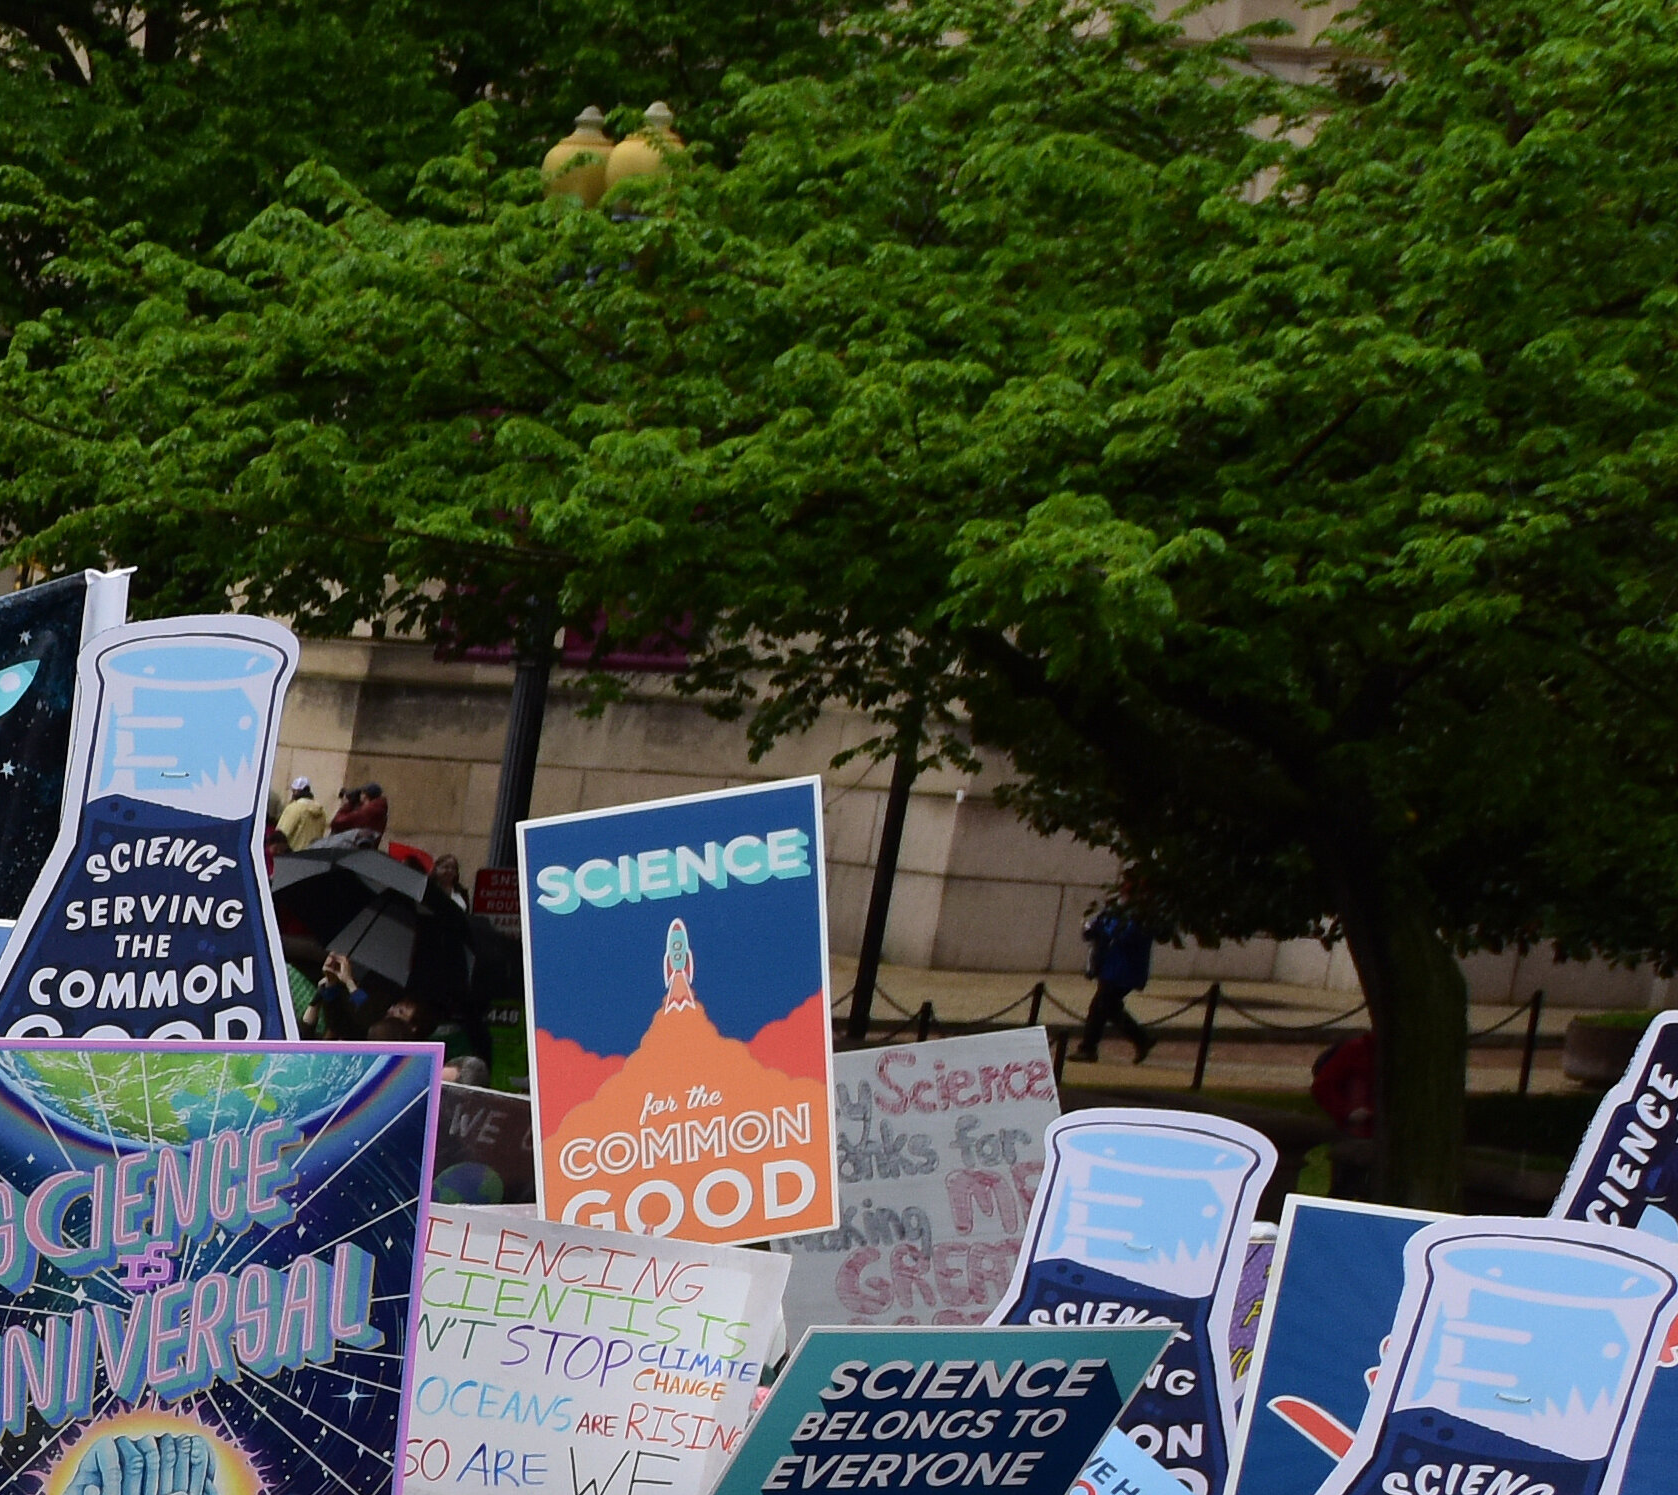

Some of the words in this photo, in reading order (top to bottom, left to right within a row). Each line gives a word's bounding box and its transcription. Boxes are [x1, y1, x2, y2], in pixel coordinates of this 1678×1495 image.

[119, 1242, 178, 1287] IS
[502, 1326, 633, 1381] STOP
[820, 1358, 1107, 1403] SCIENCE
[789, 1409, 998, 1443] BELONGS
[1006, 1408, 1067, 1438] TO
[767, 1453, 1037, 1491] EVERYONE
